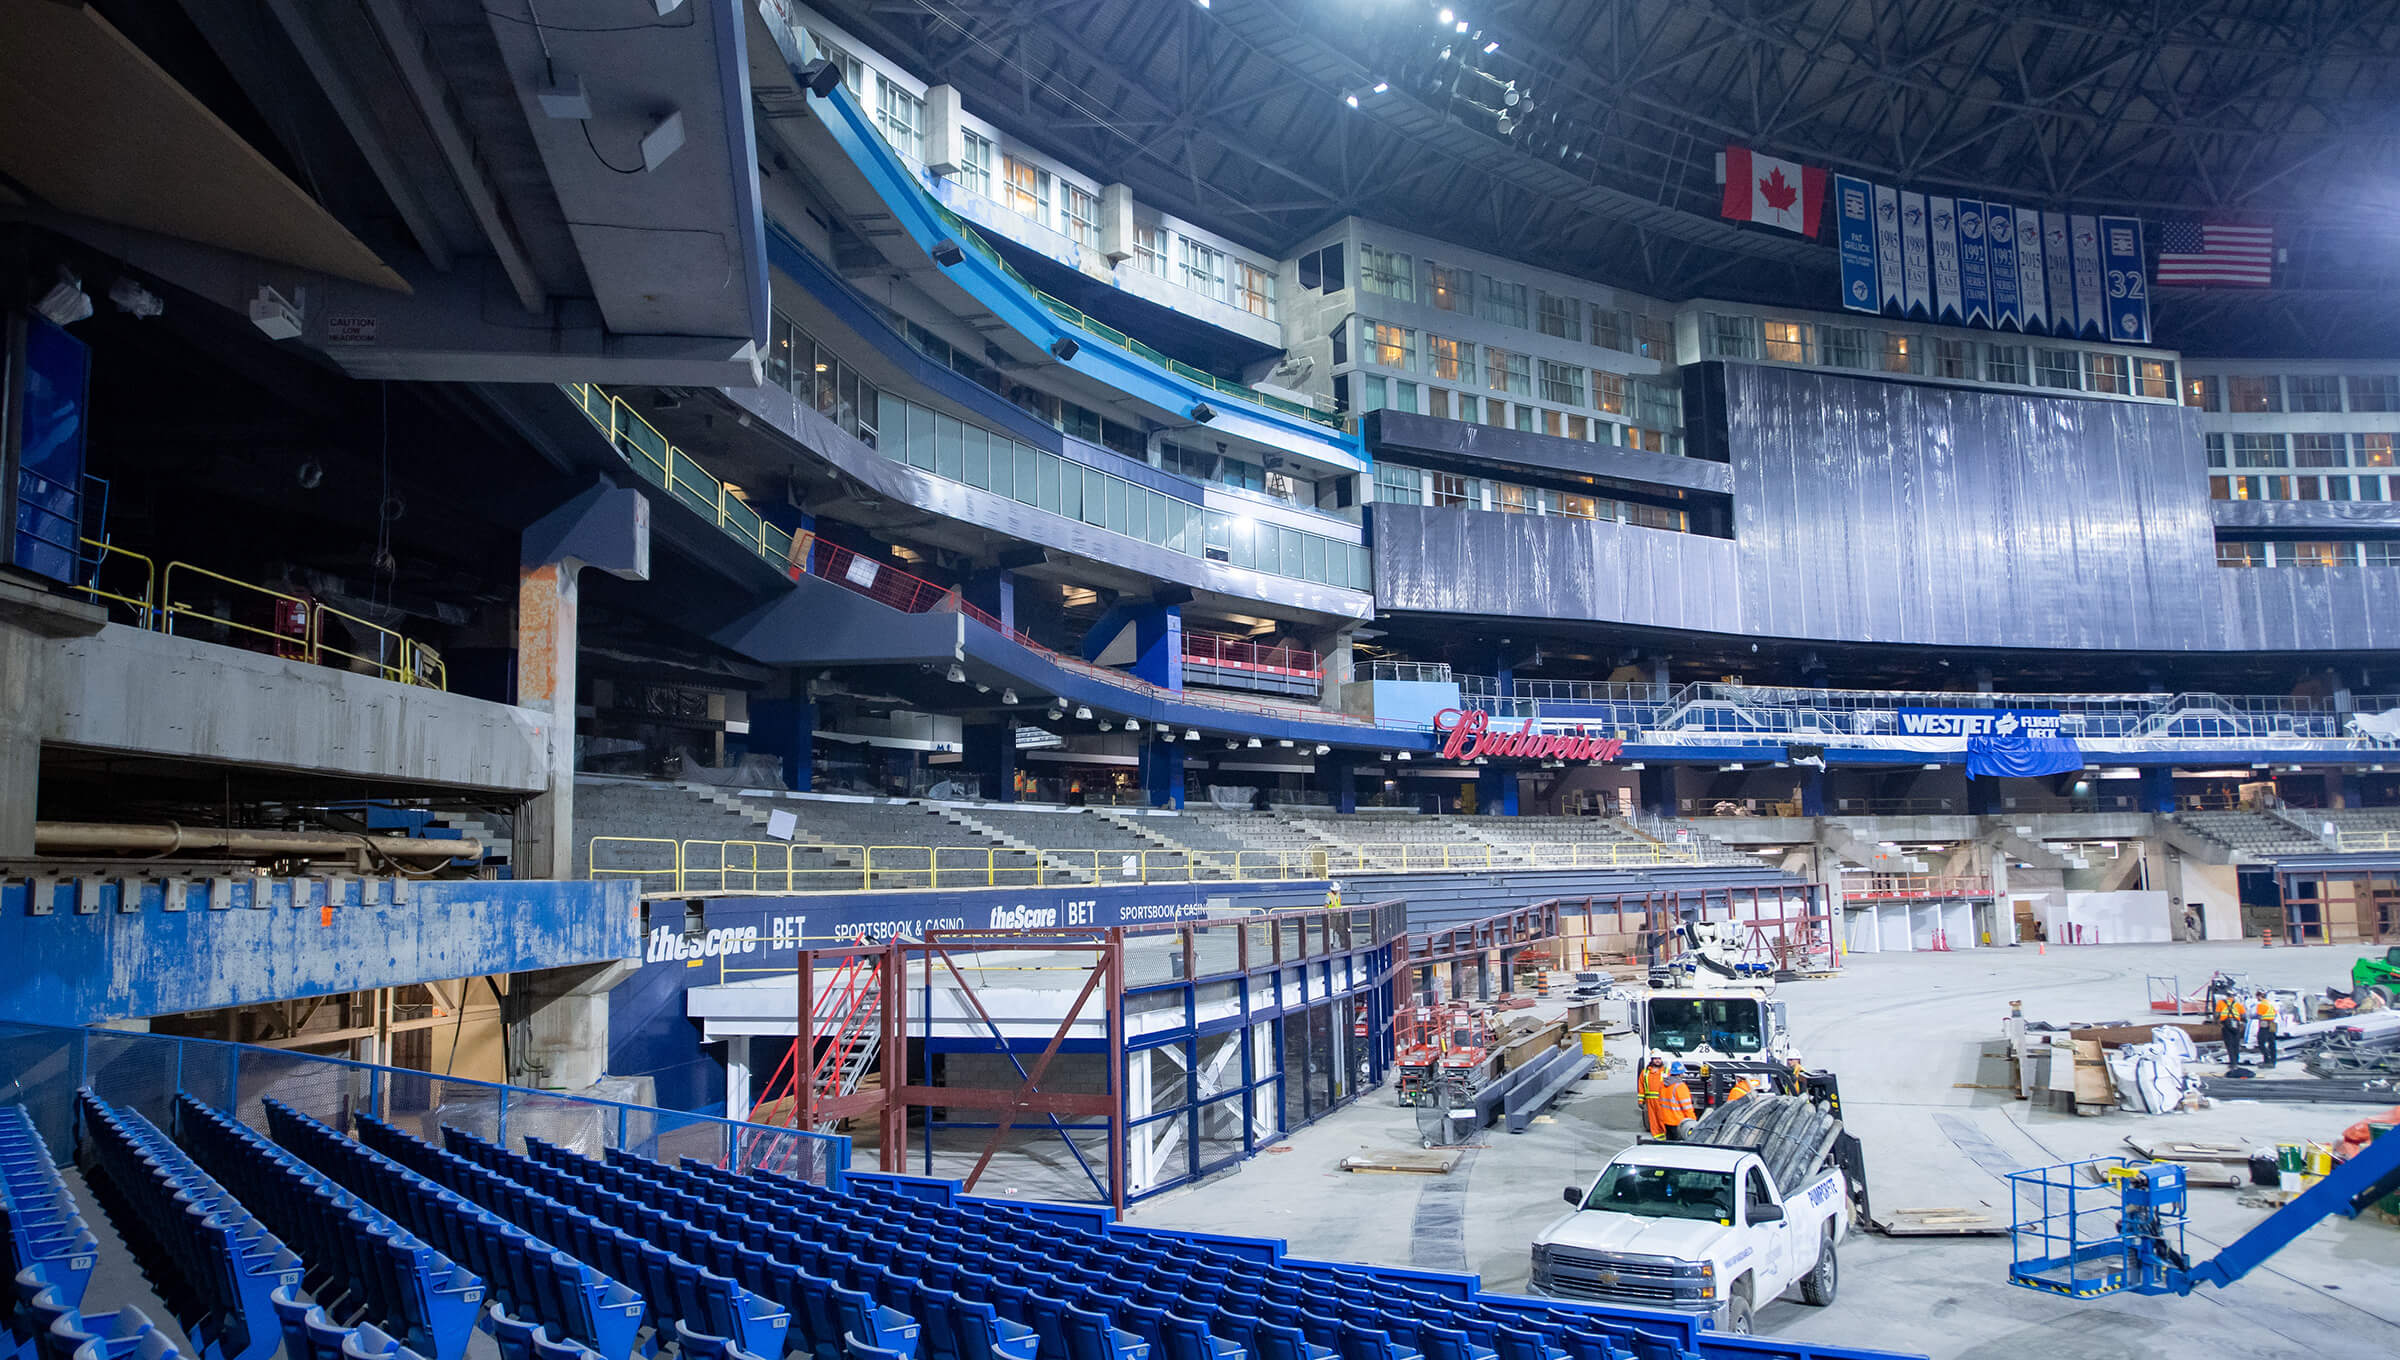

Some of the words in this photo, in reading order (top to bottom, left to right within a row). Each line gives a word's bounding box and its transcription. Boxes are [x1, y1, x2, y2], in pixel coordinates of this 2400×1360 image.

[1905, 236, 1925, 254] 1989
[1936, 240, 1955, 258] 1991
[1964, 244, 1985, 262] 1992
[1994, 248, 2014, 266] 1993
[2108, 269, 2145, 299] 32
[330, 318, 375, 327] CAUTION
[1902, 714, 1996, 738] WESTJET
[2020, 715, 2060, 729] FLIGHT
[1434, 708, 1623, 761] Budweiser
[2027, 727, 2057, 738] DECK
[989, 904, 1057, 929] theScore
[1068, 900, 1096, 925] BET
[1120, 904, 1175, 920] SPORTSBOOK
[772, 916, 806, 950] BET
[834, 919, 913, 943] SPORTSBOOK
[915, 919, 922, 937] &
[925, 916, 964, 931] CASINO
[1699, 1045, 1710, 1053] 28
